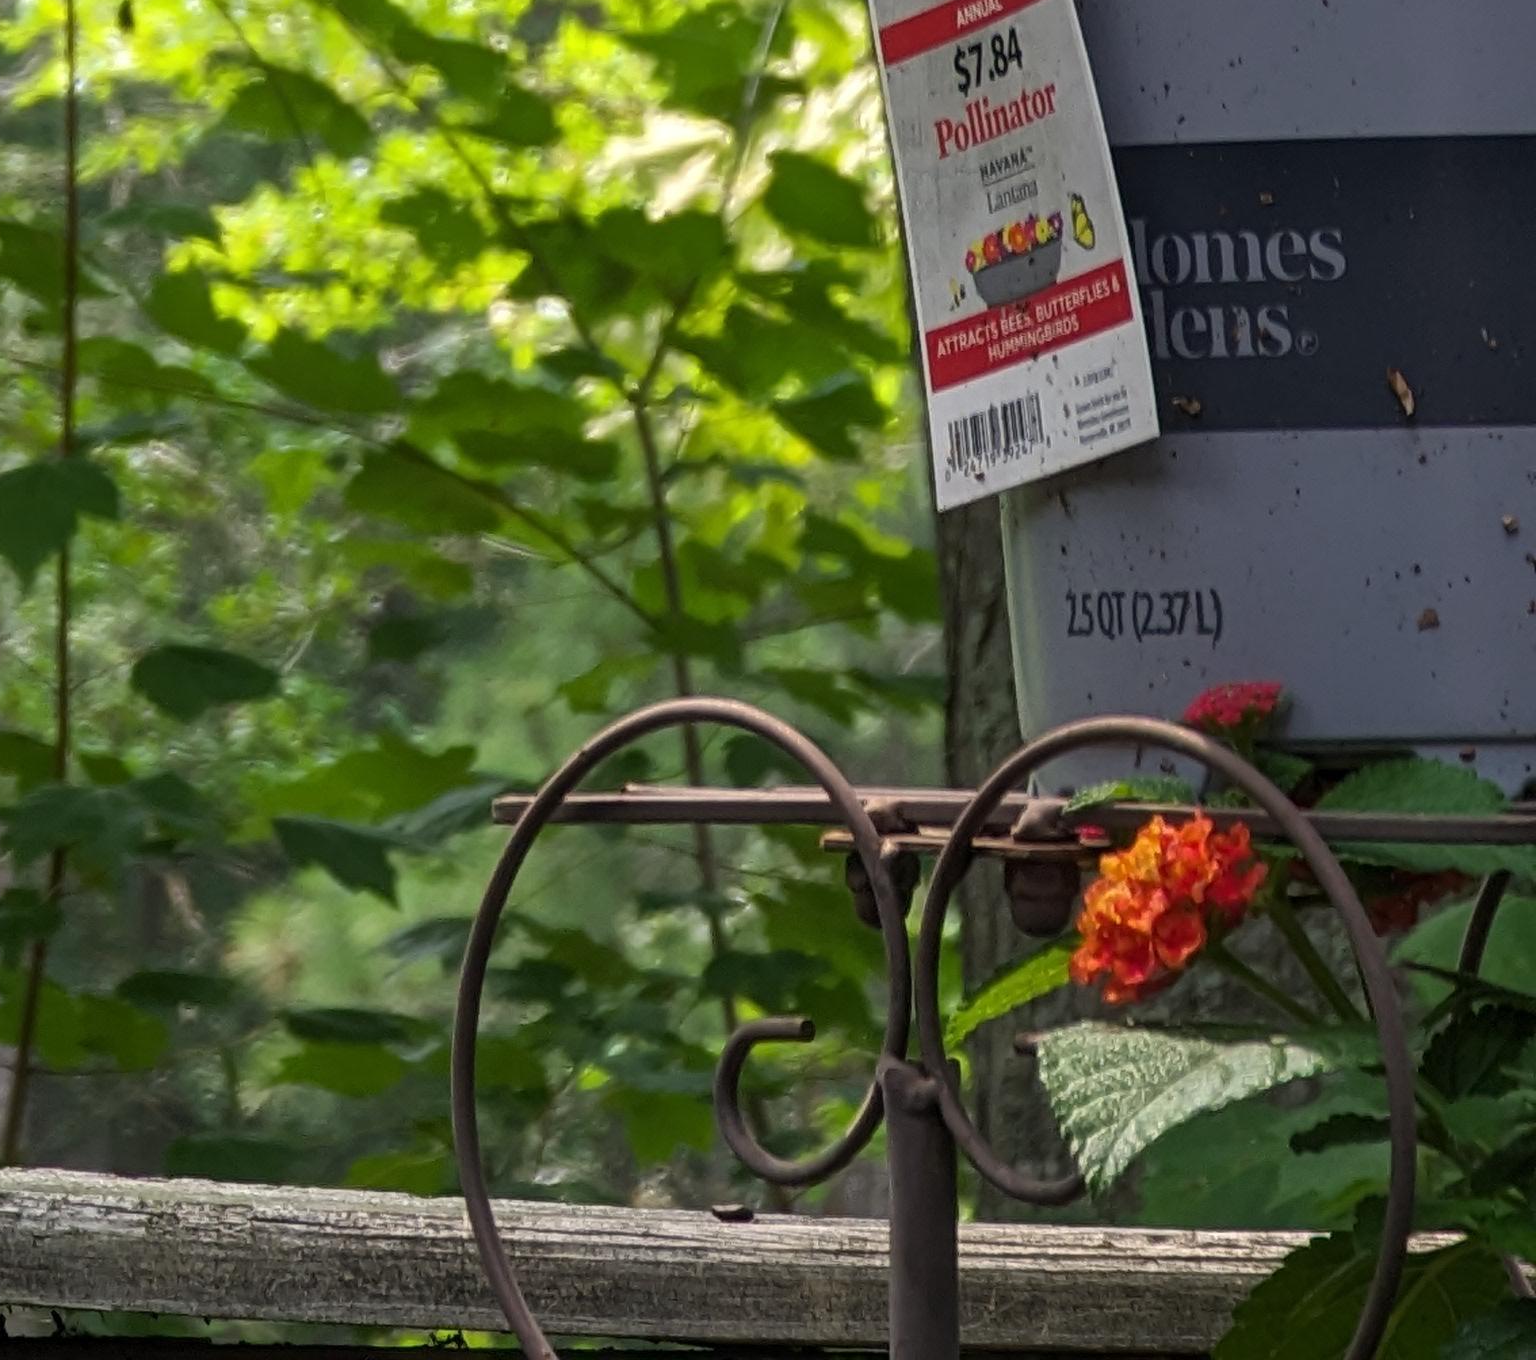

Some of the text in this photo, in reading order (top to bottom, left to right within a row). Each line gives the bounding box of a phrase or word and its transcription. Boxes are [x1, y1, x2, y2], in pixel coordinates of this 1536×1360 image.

[954, 26, 1023, 97] $7.84
[934, 82, 1056, 160] Pollinator
[987, 180, 1038, 214] Lantana
[936, 320, 998, 360] ATTRACTS
[1035, 279, 1110, 323] BUTTERFLIES
[987, 314, 1080, 363] HUMMINGBIRDS
[1097, 591, 1126, 641] QT
[1195, 588, 1223, 649] L)
